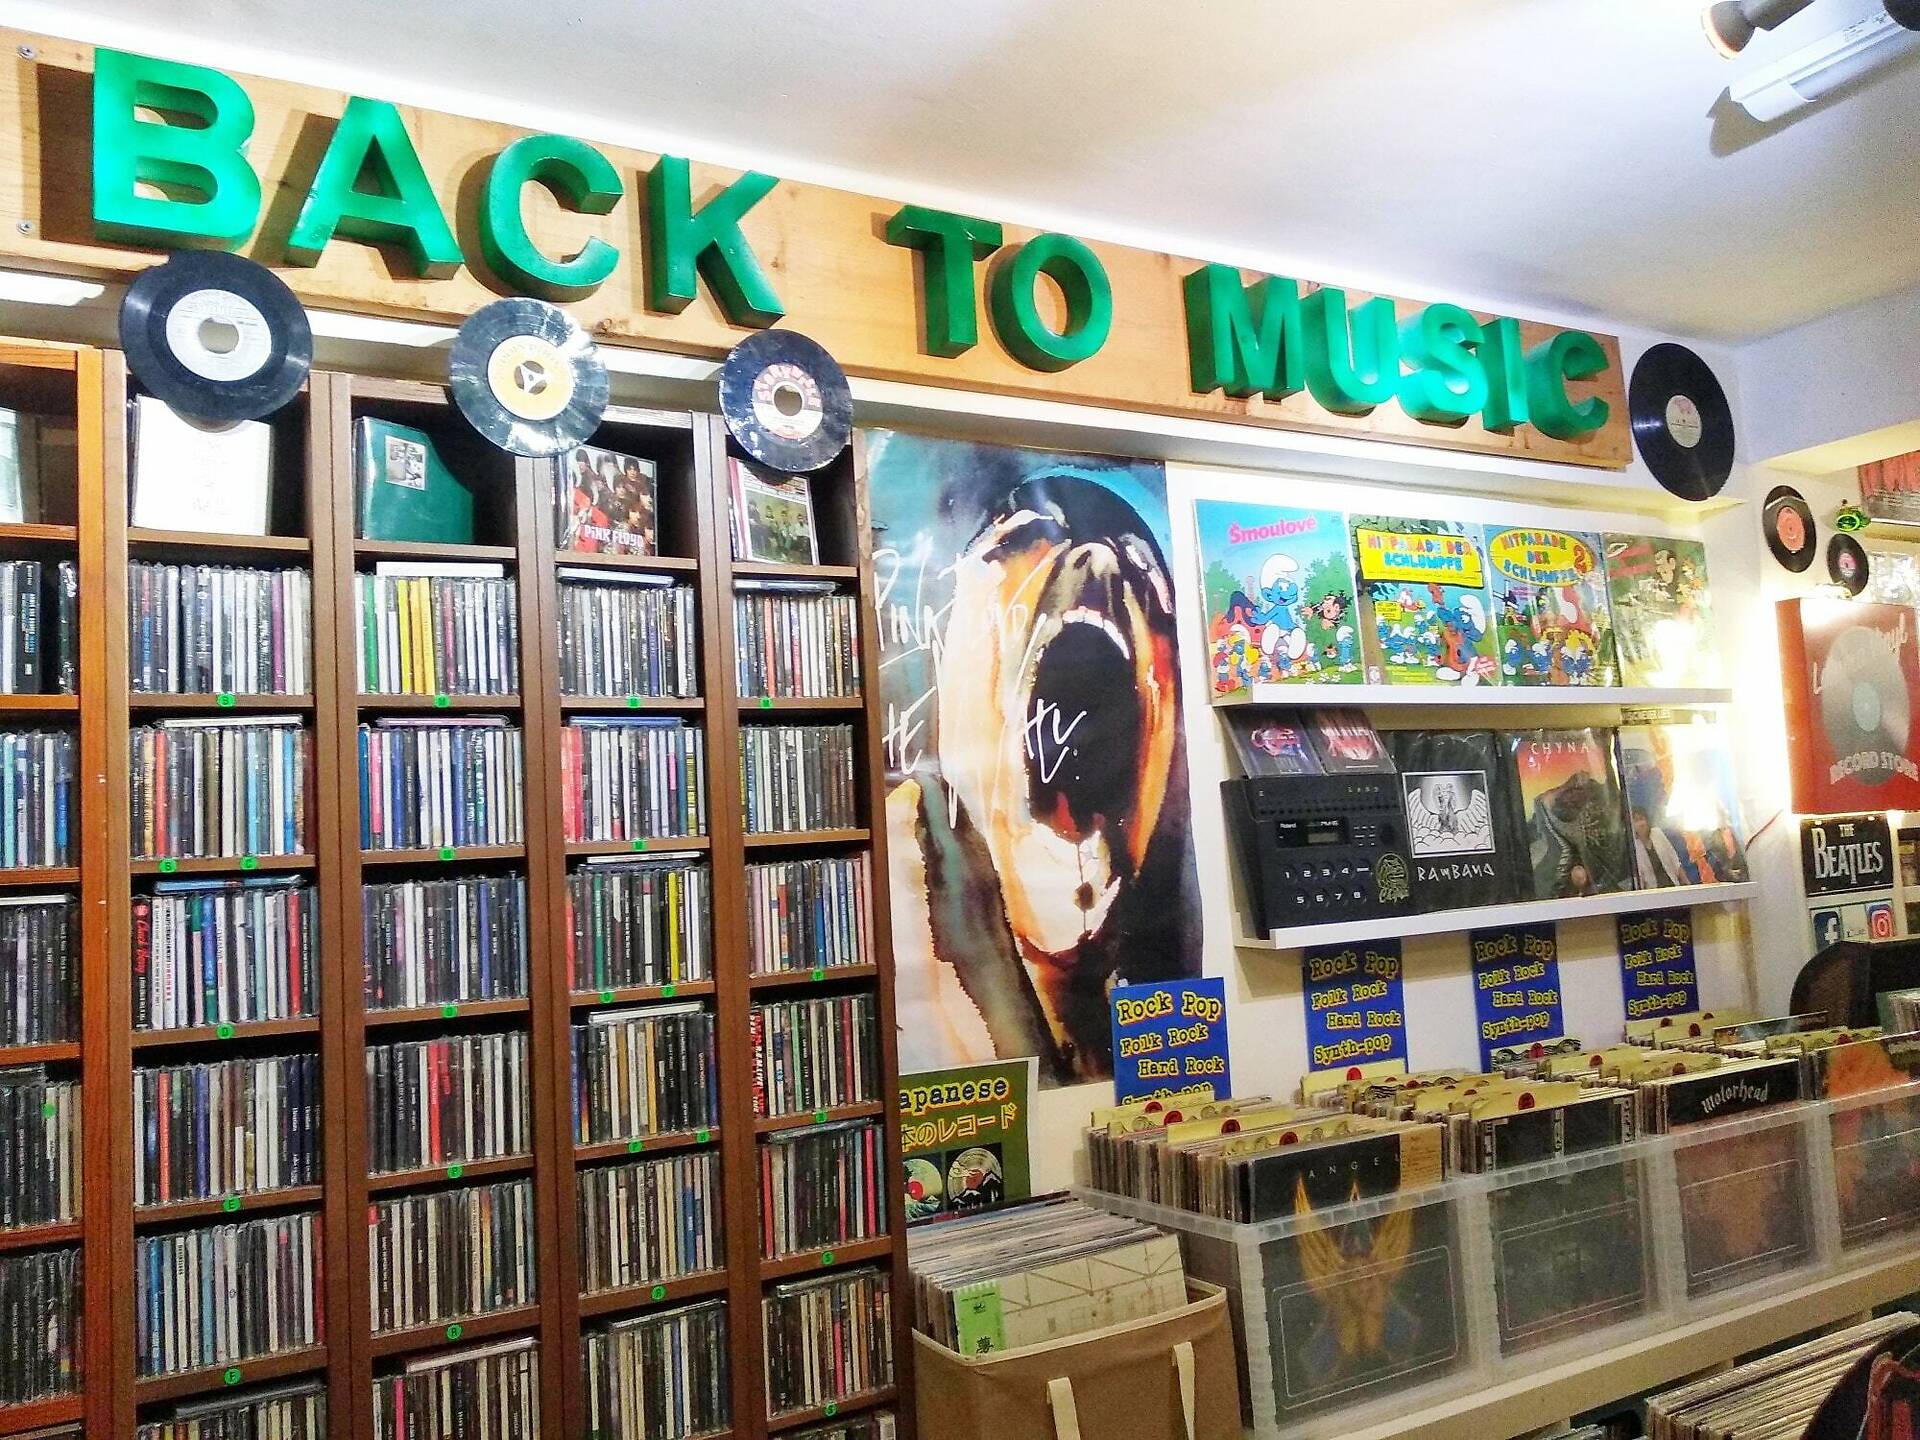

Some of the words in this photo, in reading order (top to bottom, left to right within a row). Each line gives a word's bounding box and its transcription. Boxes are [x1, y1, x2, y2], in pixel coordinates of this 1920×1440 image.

[93, 47, 785, 327] BACK
[886, 205, 1112, 372] TO
[1186, 263, 1610, 440] MUSIC
[1228, 515, 1317, 545] Šmoulové
[1367, 534, 1441, 553] HITPARADE
[1446, 540, 1472, 556] DER
[1530, 741, 1591, 756] CHYNA
[1838, 824, 1855, 838] THE
[1811, 827, 1883, 884] BEATLES
[1303, 870, 1312, 878] 2
[1322, 868, 1331, 877] 3
[1296, 896, 1305, 904] 5
[1622, 921, 1657, 943] Rock
[1663, 918, 1689, 943] Pop
[1475, 934, 1516, 961] Rock
[1524, 934, 1555, 961] Pop
[1624, 951, 1651, 969] Folk
[1655, 944, 1682, 961] Rock
[1310, 951, 1357, 980] Rock
[1365, 951, 1399, 980] Pop
[1479, 970, 1510, 989] Folk
[1514, 962, 1545, 980] Rock
[1637, 972, 1664, 985] Hard
[1668, 970, 1694, 985] Rock
[1117, 991, 1173, 1024] Rock
[1183, 990, 1221, 1022] Pop
[1311, 988, 1347, 1010] Folk
[1352, 980, 1387, 998] Rock
[1493, 991, 1523, 1007] Hard
[1528, 989, 1558, 1004] Rock
[1628, 991, 1687, 1016] Synth-pop
[1327, 1011, 1361, 1029] Hard
[1367, 1010, 1401, 1026] Rock
[1482, 1011, 1550, 1040] Synth-pop
[1121, 1032, 1162, 1057] Folk
[1168, 1024, 1208, 1045] Rock
[1314, 1034, 1392, 1065] Synth-pop
[1138, 1059, 1178, 1078] Hard
[1186, 1057, 1224, 1073] Rock
